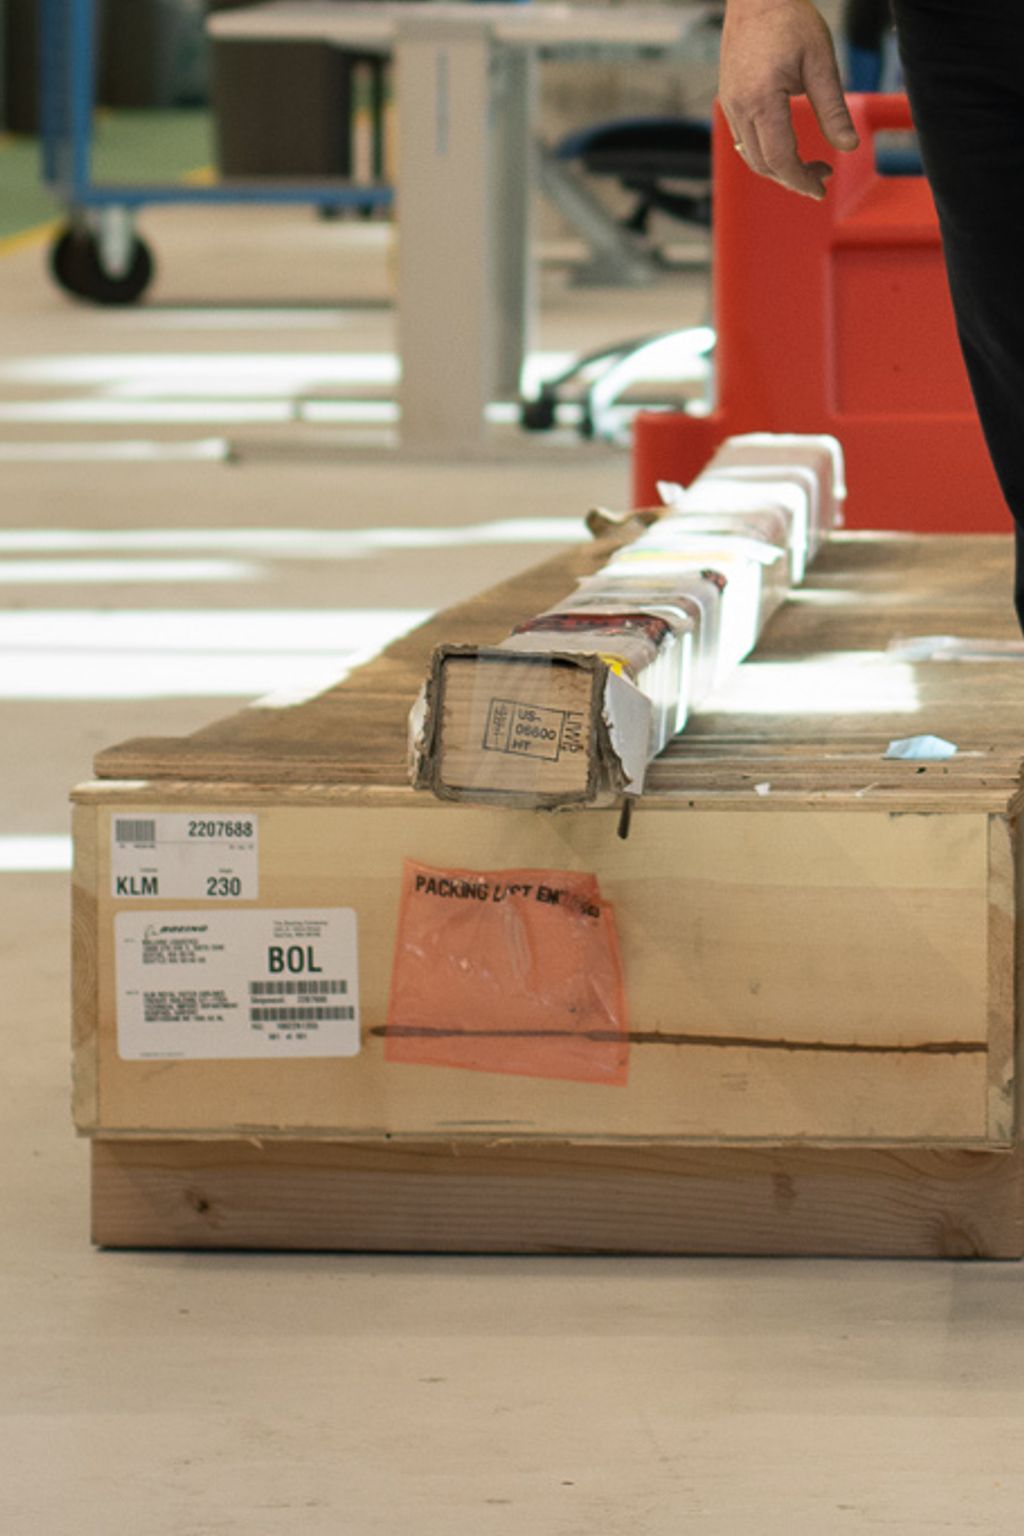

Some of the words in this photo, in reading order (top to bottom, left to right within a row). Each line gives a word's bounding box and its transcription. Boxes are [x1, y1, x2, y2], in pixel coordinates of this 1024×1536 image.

[188, 820, 253, 837] 2207688
[116, 876, 159, 896] KLM
[207, 876, 242, 896] 230
[416, 875, 488, 901] PACKING
[268, 946, 323, 973] BOL
